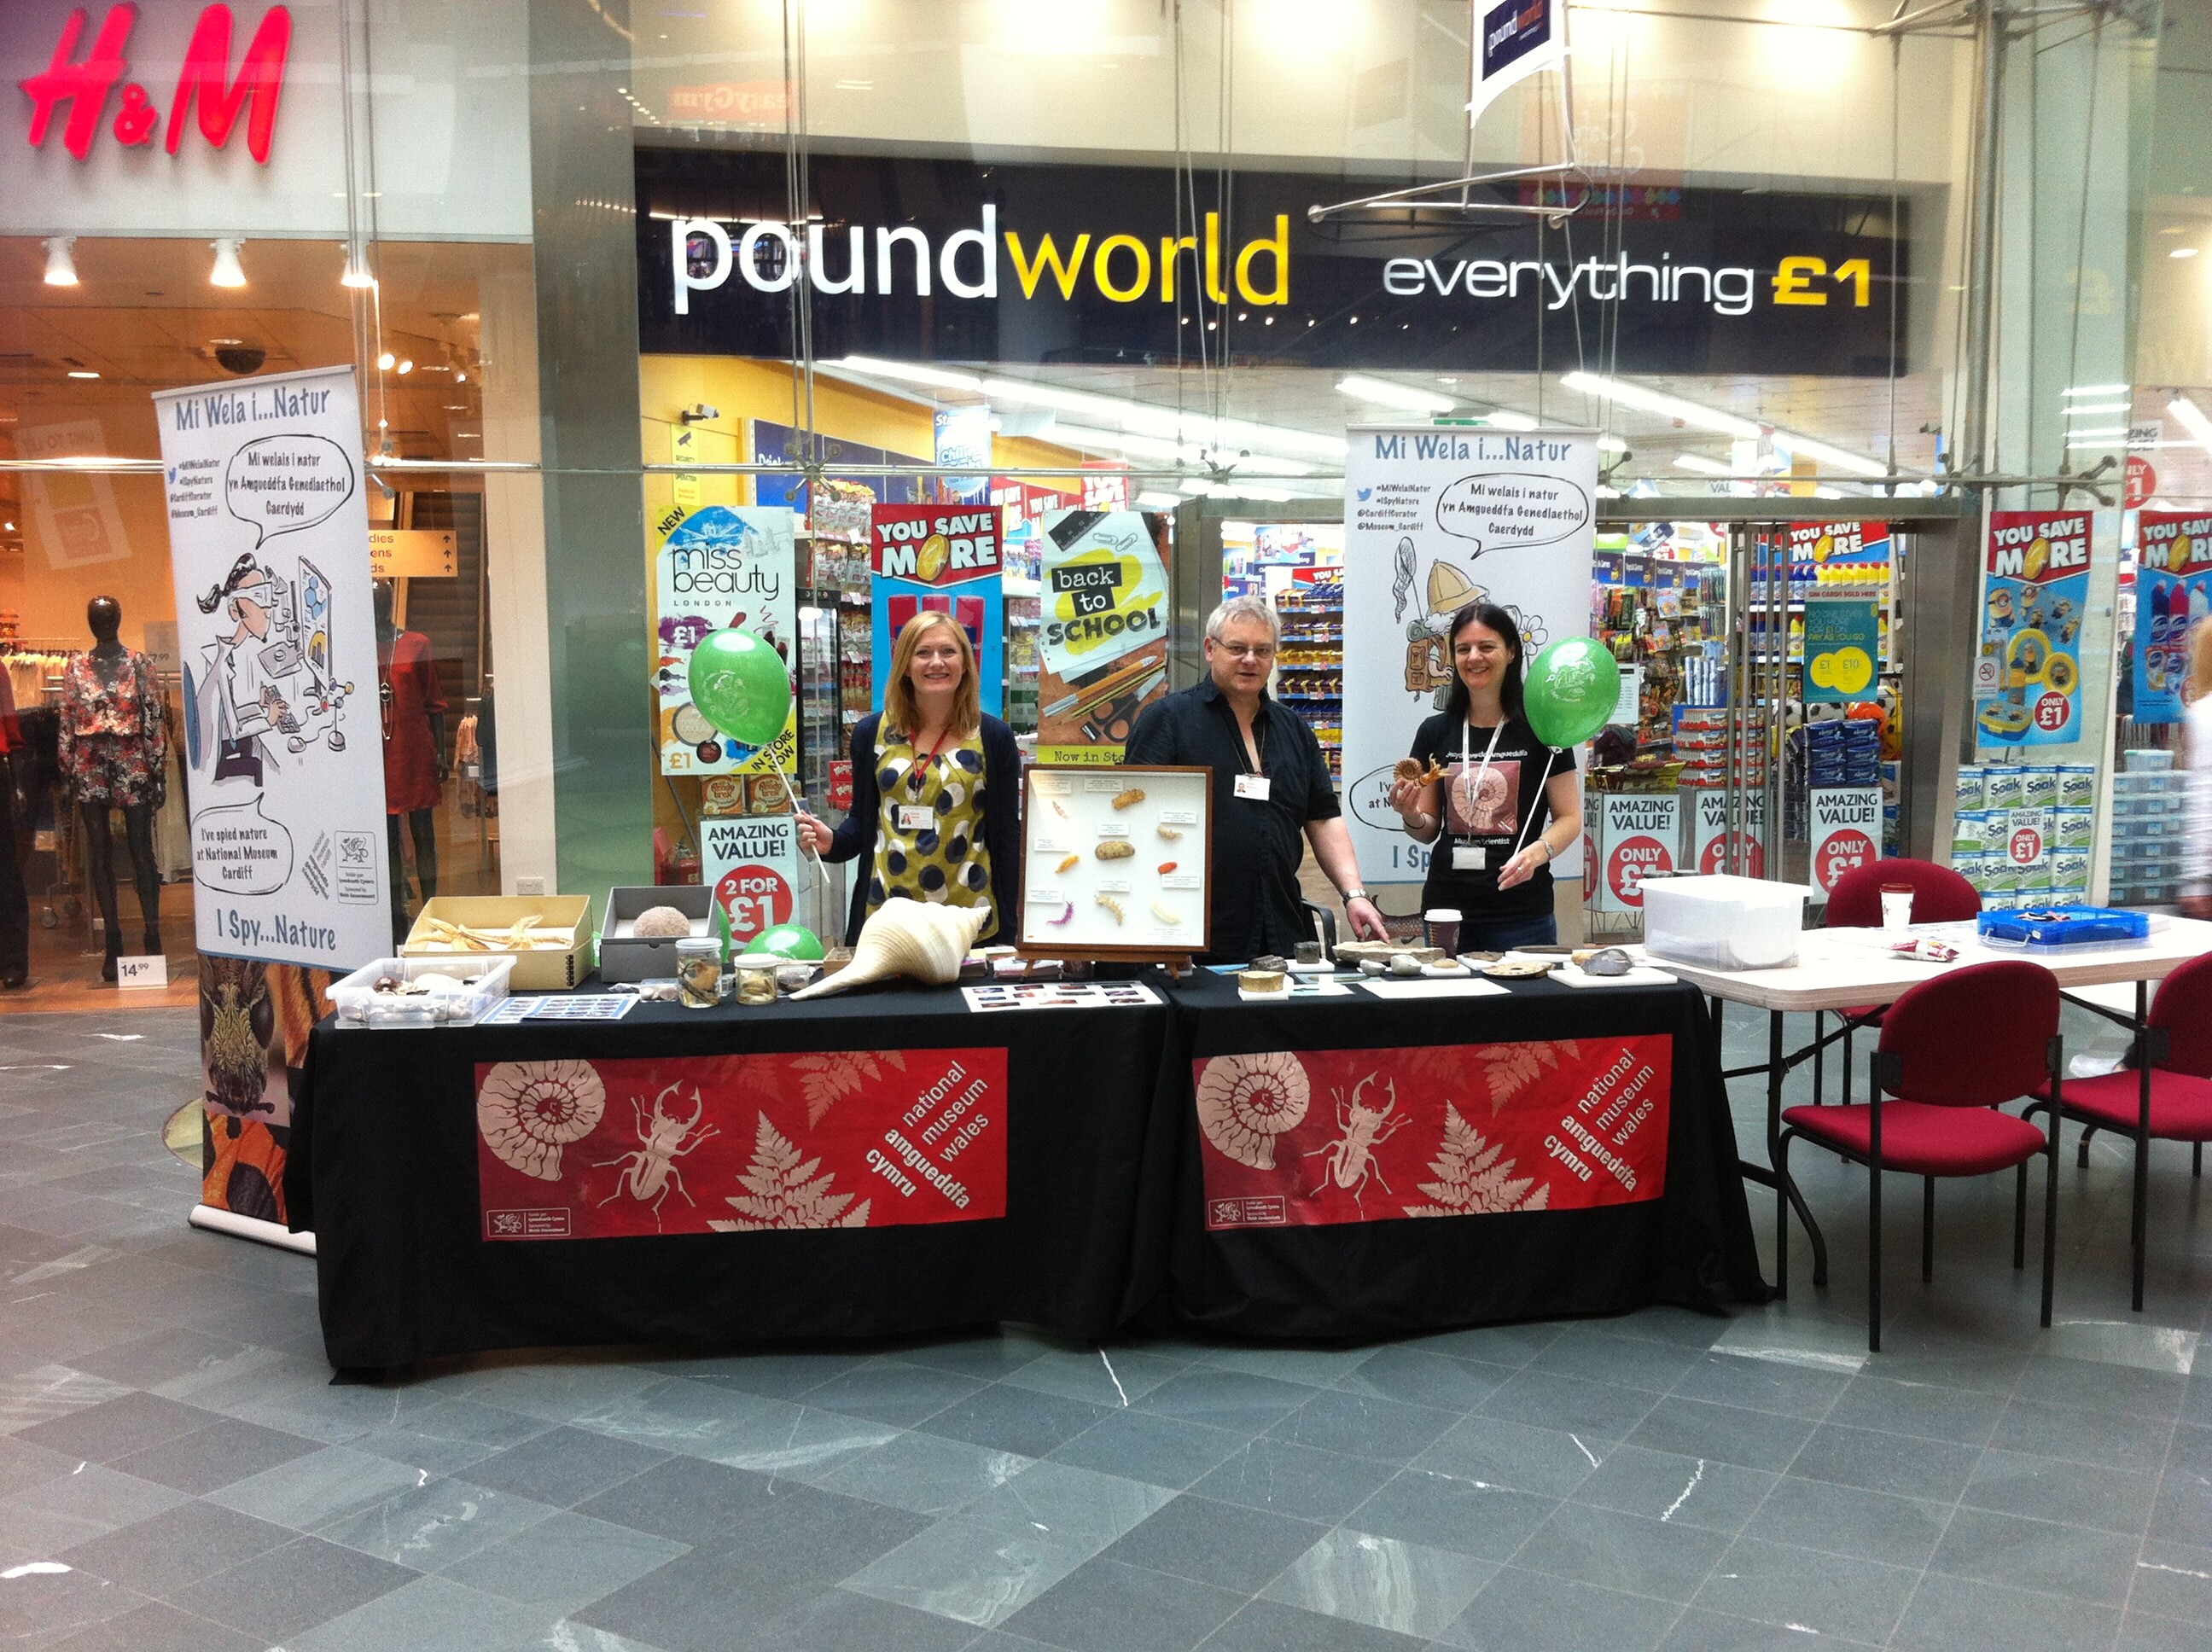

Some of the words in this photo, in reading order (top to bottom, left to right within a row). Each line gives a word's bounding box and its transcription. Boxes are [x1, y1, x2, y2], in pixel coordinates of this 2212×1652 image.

[19, 3, 292, 164] H&M
[670, 204, 1289, 315] poundworld
[1382, 253, 1754, 315] everything
[1772, 256, 1871, 307] £1
[177, 399, 200, 430] Mi
[206, 393, 246, 428] Wela
[1375, 434, 1406, 460] Mi
[1415, 434, 1470, 460] Wela
[248, 451, 260, 466] Mi
[262, 451, 289, 467] welais
[297, 454, 321, 467] natur
[229, 479, 238, 492] yn
[1470, 483, 1485, 496] Mi
[1487, 484, 1520, 498] welais
[1528, 488, 1559, 501] natur
[1710, 483, 1731, 493] VAL
[266, 500, 305, 517] Caerdydd
[1442, 502, 1455, 513] yn
[1458, 501, 1514, 516] Amgueddfa
[1517, 505, 1583, 521] Genedlaethol
[656, 506, 685, 535] NEW
[876, 520, 928, 543] YOU
[934, 513, 993, 536] SAVE
[369, 533, 394, 544] dies
[1488, 522, 1534, 538] Caerdydd
[1790, 526, 1820, 542] YOU
[1825, 522, 1860, 536] SAVE
[1994, 525, 2034, 547] YOU
[2038, 517, 2087, 539] SAVE
[2143, 523, 2177, 542] YOU
[2181, 518, 2212, 536] SAV
[370, 550, 393, 558] ens
[672, 542, 742, 570] miss
[370, 563, 385, 573] ds
[1313, 570, 1331, 580] YOU
[673, 564, 779, 601] beauty
[1057, 567, 1115, 589] back
[1080, 593, 1106, 612] to
[672, 625, 697, 644] £1
[1046, 608, 1161, 646] SCHOOL
[2041, 697, 2065, 707] ONLY
[2040, 707, 2064, 726] £1
[670, 752, 693, 770] £1
[1054, 751, 1080, 763] Now
[1084, 752, 1098, 762] in
[1103, 752, 1124, 763] Sto
[1487, 749, 1528, 759] mgueddfa
[750, 759, 765, 773] IN
[1991, 777, 2022, 795] Soak
[2027, 777, 2056, 793] Soak
[2063, 777, 2093, 793] Soak
[1368, 799, 1380, 809] at
[1609, 800, 1674, 813] AMAZING
[1816, 794, 1877, 807] AMAZING
[1611, 815, 1670, 830] VALUE!
[1819, 808, 1875, 824] VALUE!
[2012, 817, 2040, 827] VALUE!
[707, 823, 789, 841] AMAZING
[2062, 817, 2091, 834] Soak
[217, 828, 236, 843] spied
[239, 828, 268, 840] nature
[2015, 834, 2036, 842] ONLY
[197, 848, 204, 861] at
[205, 846, 242, 861] National
[243, 846, 278, 860] Museum
[712, 840, 785, 861] VALUE!
[1620, 847, 1662, 862] ONLY
[1827, 841, 1867, 855] ONLY
[2015, 842, 2034, 859] £1
[222, 865, 253, 880] Cardiff
[2057, 857, 2087, 874] Soak
[725, 880, 737, 895] 2
[740, 877, 778, 894] FOR
[217, 908, 223, 937] I
[729, 895, 774, 933] £1
[1577, 1047, 1636, 1114] national
[902, 1060, 967, 1127] national
[1596, 1065, 1655, 1131] museum
[922, 1079, 988, 1145] museum
[1611, 1098, 1654, 1147] wales
[940, 1114, 989, 1162] wales
[1544, 1135, 1593, 1183] cymru
[1561, 1114, 1637, 1193] amgueddfa
[865, 1149, 917, 1198] cymru
[884, 1129, 970, 1210] amgueddfa
